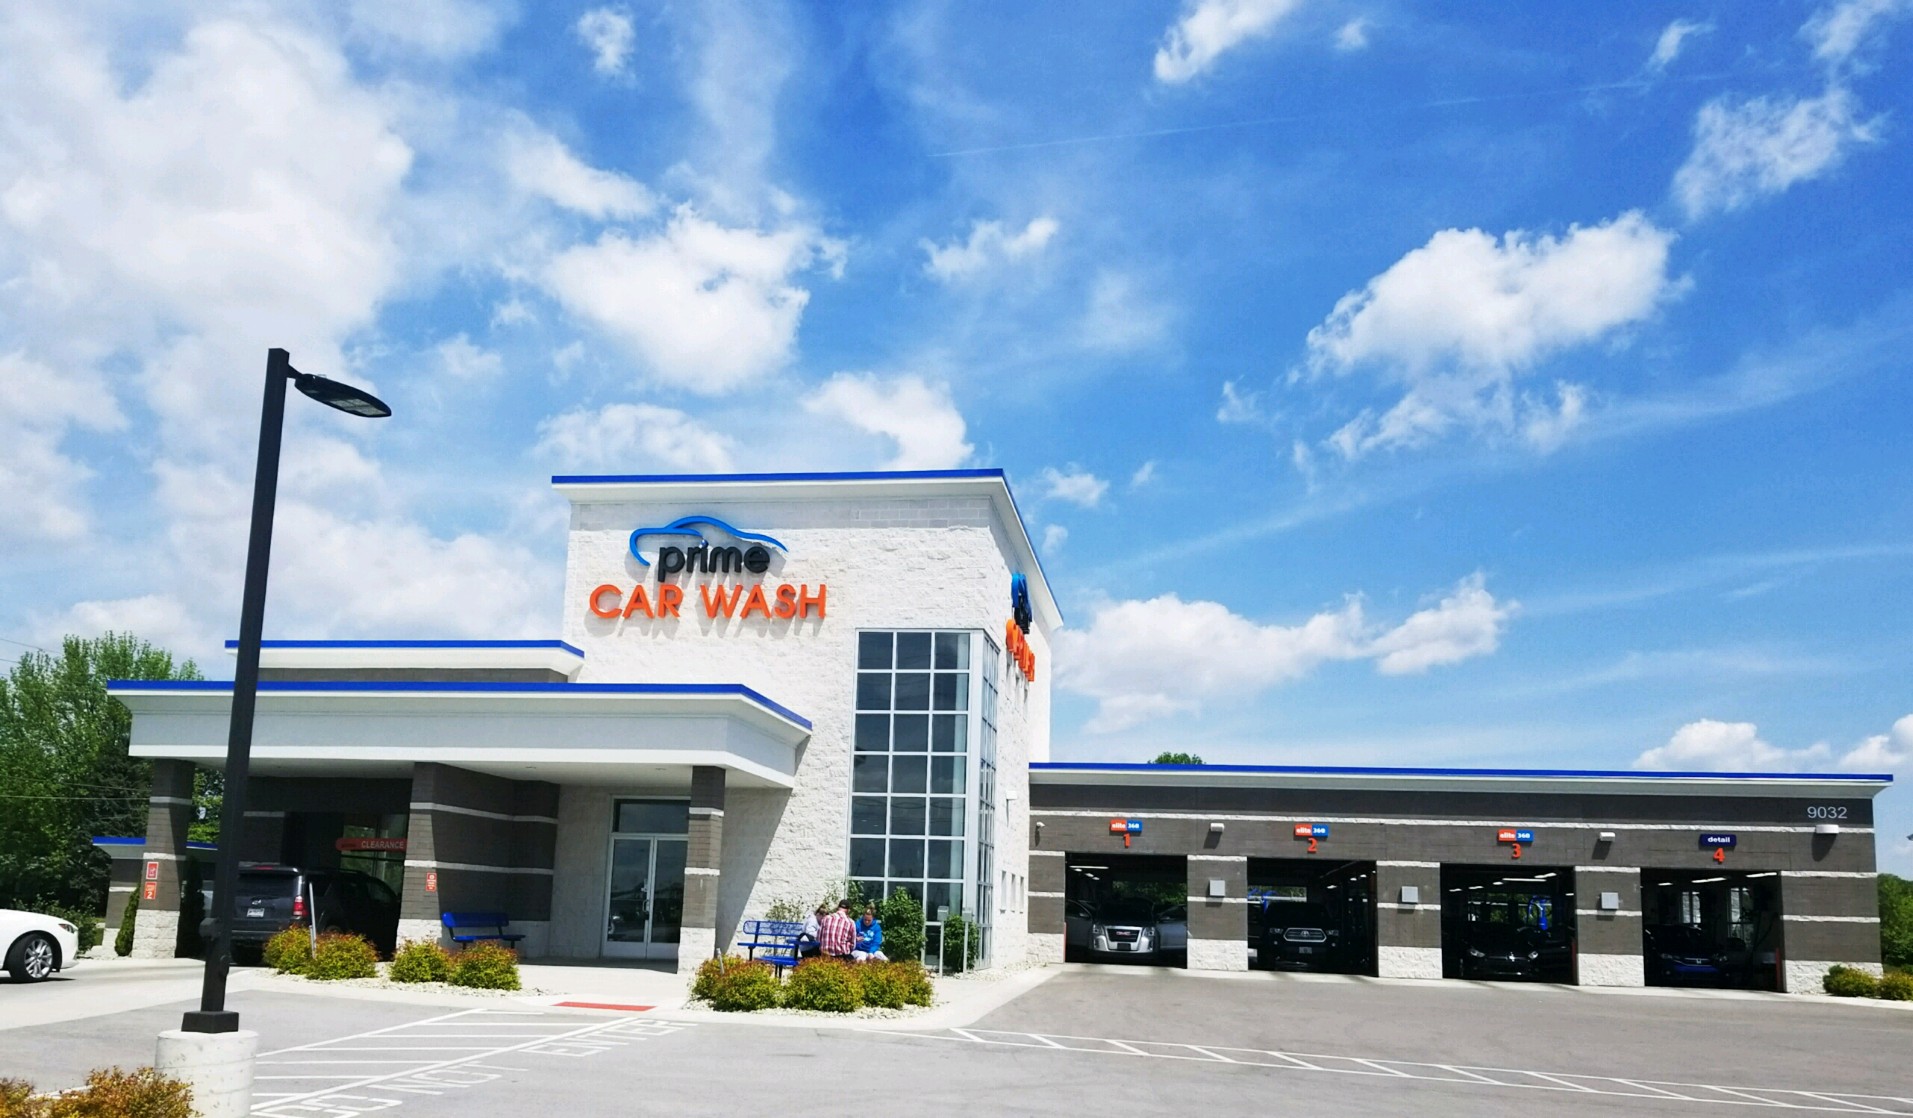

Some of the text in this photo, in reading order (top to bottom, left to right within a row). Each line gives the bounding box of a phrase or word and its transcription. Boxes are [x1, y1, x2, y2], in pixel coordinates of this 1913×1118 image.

[657, 538, 771, 583] prime
[589, 583, 827, 619] CAR WASH
[1807, 806, 1848, 819] 9032
[361, 840, 404, 849] CLEARANCE
[1123, 833, 1130, 847] 1
[1307, 837, 1318, 852] 2
[1512, 843, 1521, 858] 3
[1713, 847, 1726, 863] 4
[366, 1060, 530, 1096] NOT
[518, 1019, 699, 1057] ENTER
